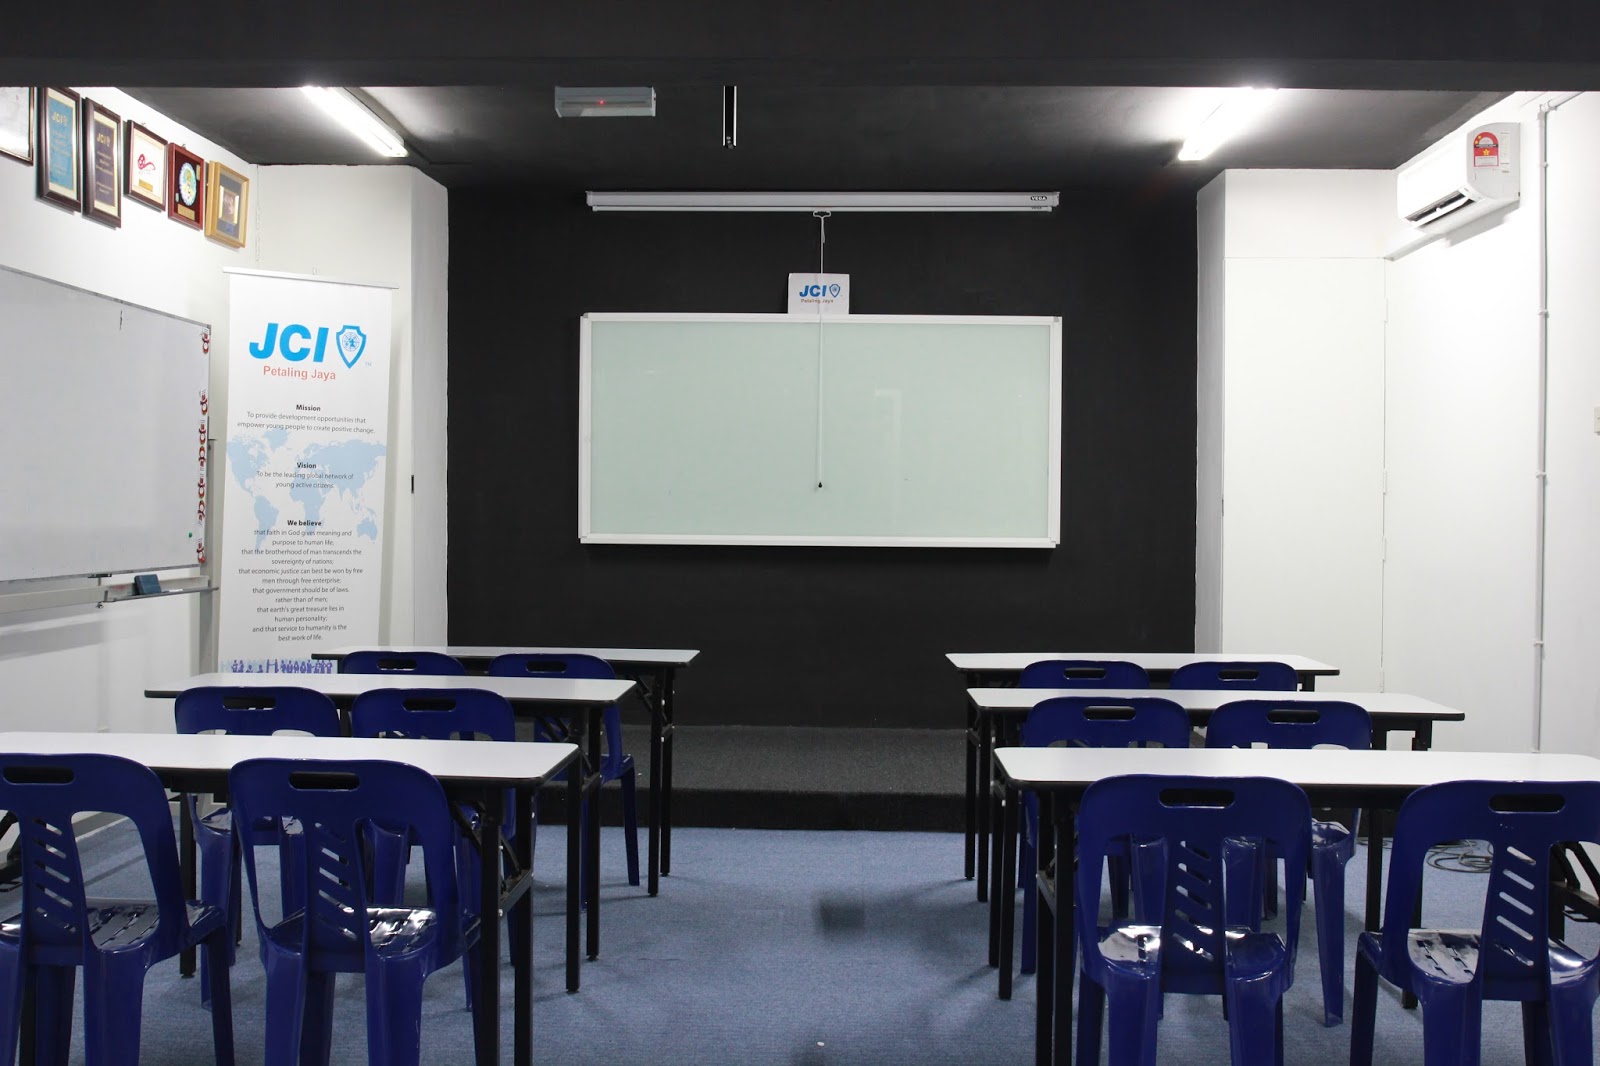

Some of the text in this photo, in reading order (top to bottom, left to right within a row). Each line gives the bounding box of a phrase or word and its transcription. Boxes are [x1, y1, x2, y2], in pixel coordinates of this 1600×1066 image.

[799, 284, 827, 297] JCI
[249, 322, 329, 363] JCI
[263, 366, 336, 381] Petaling Jaya
